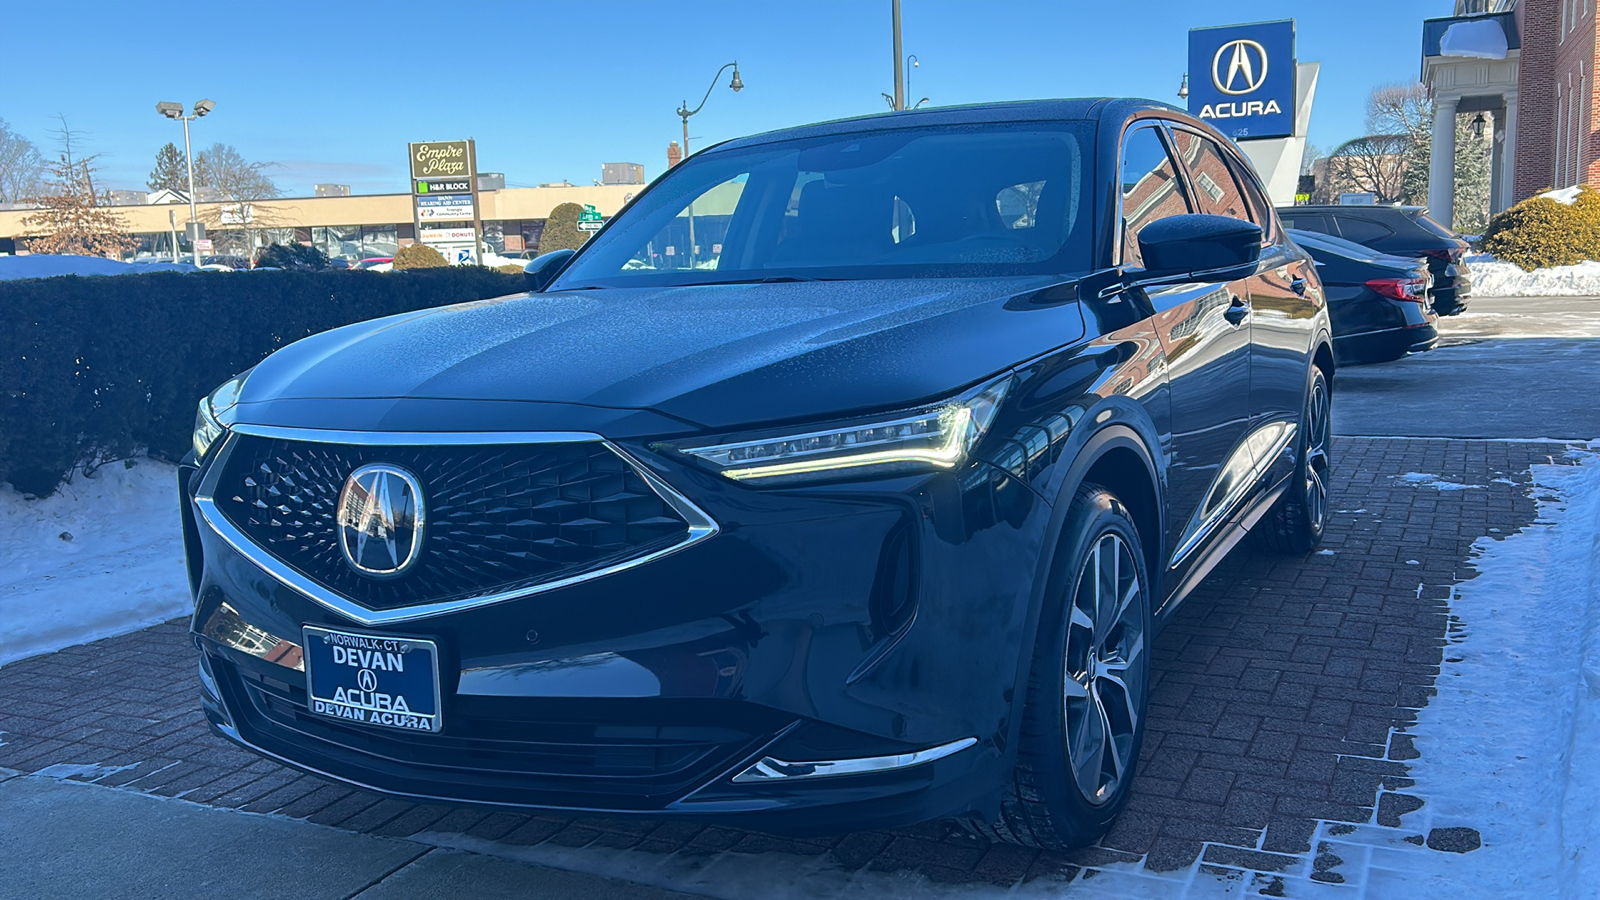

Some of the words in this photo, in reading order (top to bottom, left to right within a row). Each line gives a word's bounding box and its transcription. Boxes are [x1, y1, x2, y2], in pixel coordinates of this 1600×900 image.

[1199, 100, 1281, 119] ACURA
[416, 145, 463, 161] Empire
[423, 159, 464, 174] Plaza
[429, 183, 445, 191] H&R
[384, 640, 398, 651] CT
[332, 645, 404, 672] DEVAN
[333, 686, 411, 713] ACURA
[315, 701, 365, 721] DEVAN
[370, 712, 431, 730] ACURA
